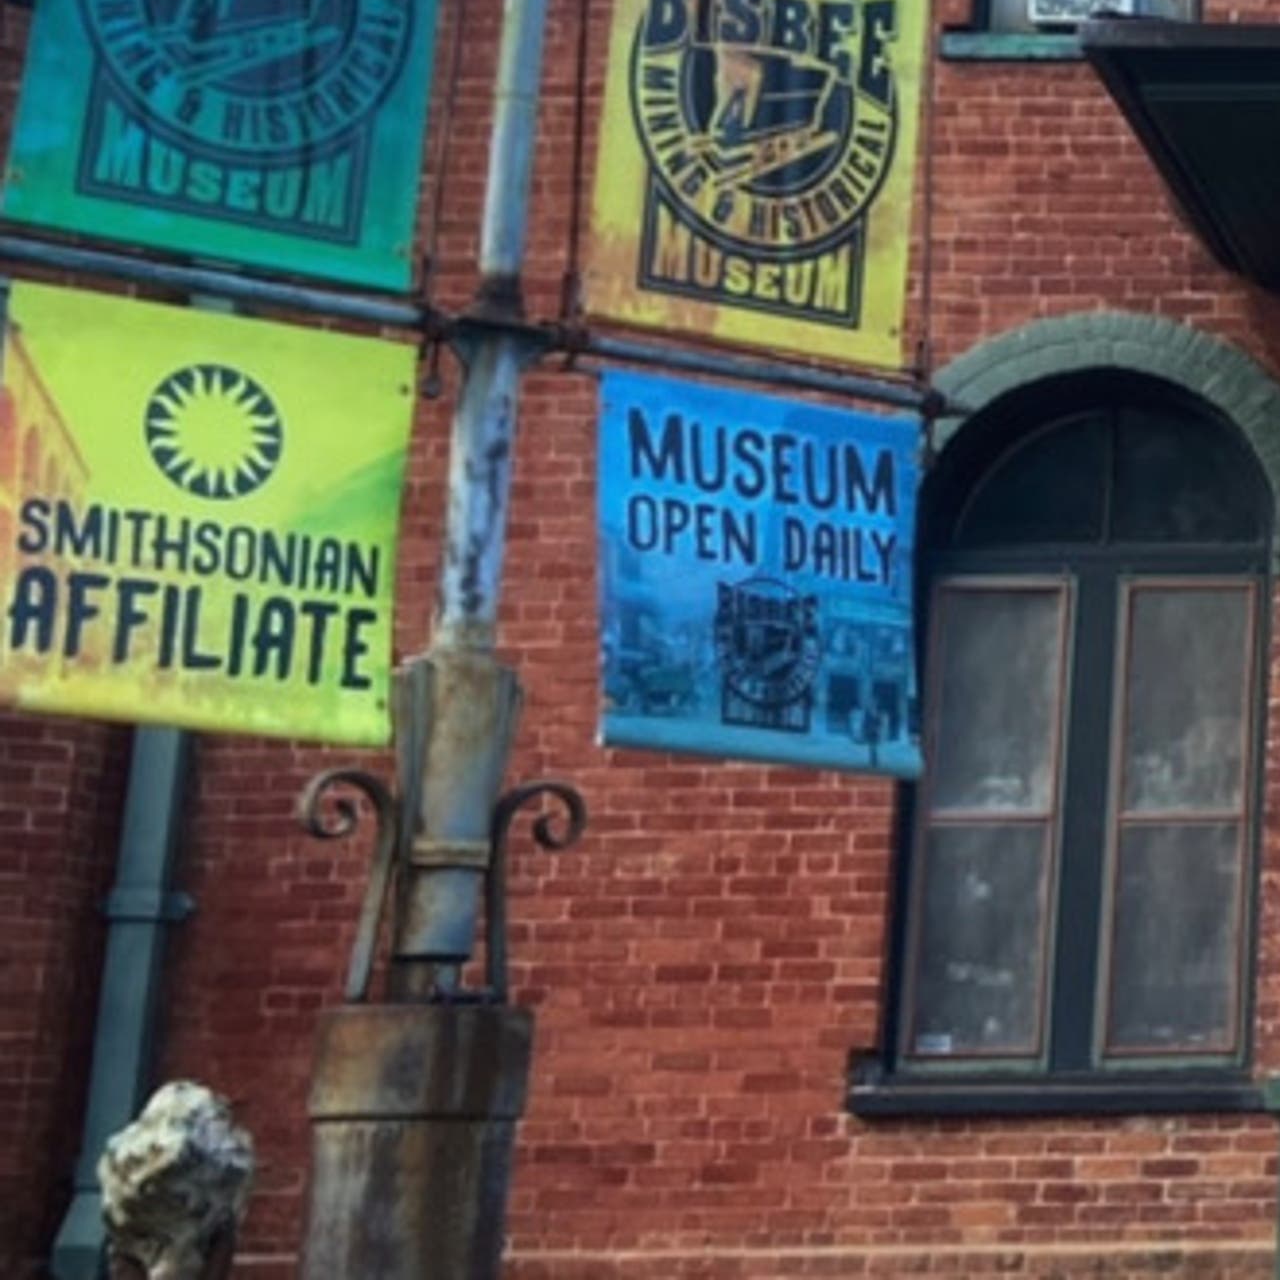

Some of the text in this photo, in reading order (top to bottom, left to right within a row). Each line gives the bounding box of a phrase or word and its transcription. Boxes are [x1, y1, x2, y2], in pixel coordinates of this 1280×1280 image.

[223, 12, 401, 143] HISTORICAL
[94, 104, 351, 228] MUSEUM
[643, 65, 709, 193] MINING
[750, 121, 886, 240] HISTORICAL
[653, 200, 848, 311] MUSEUM
[628, 406, 897, 517] MUSEUM
[17, 498, 380, 598] SMITHSONIAN
[628, 494, 898, 587] OPEN DAILY
[9, 566, 377, 689] AFFILIATE
